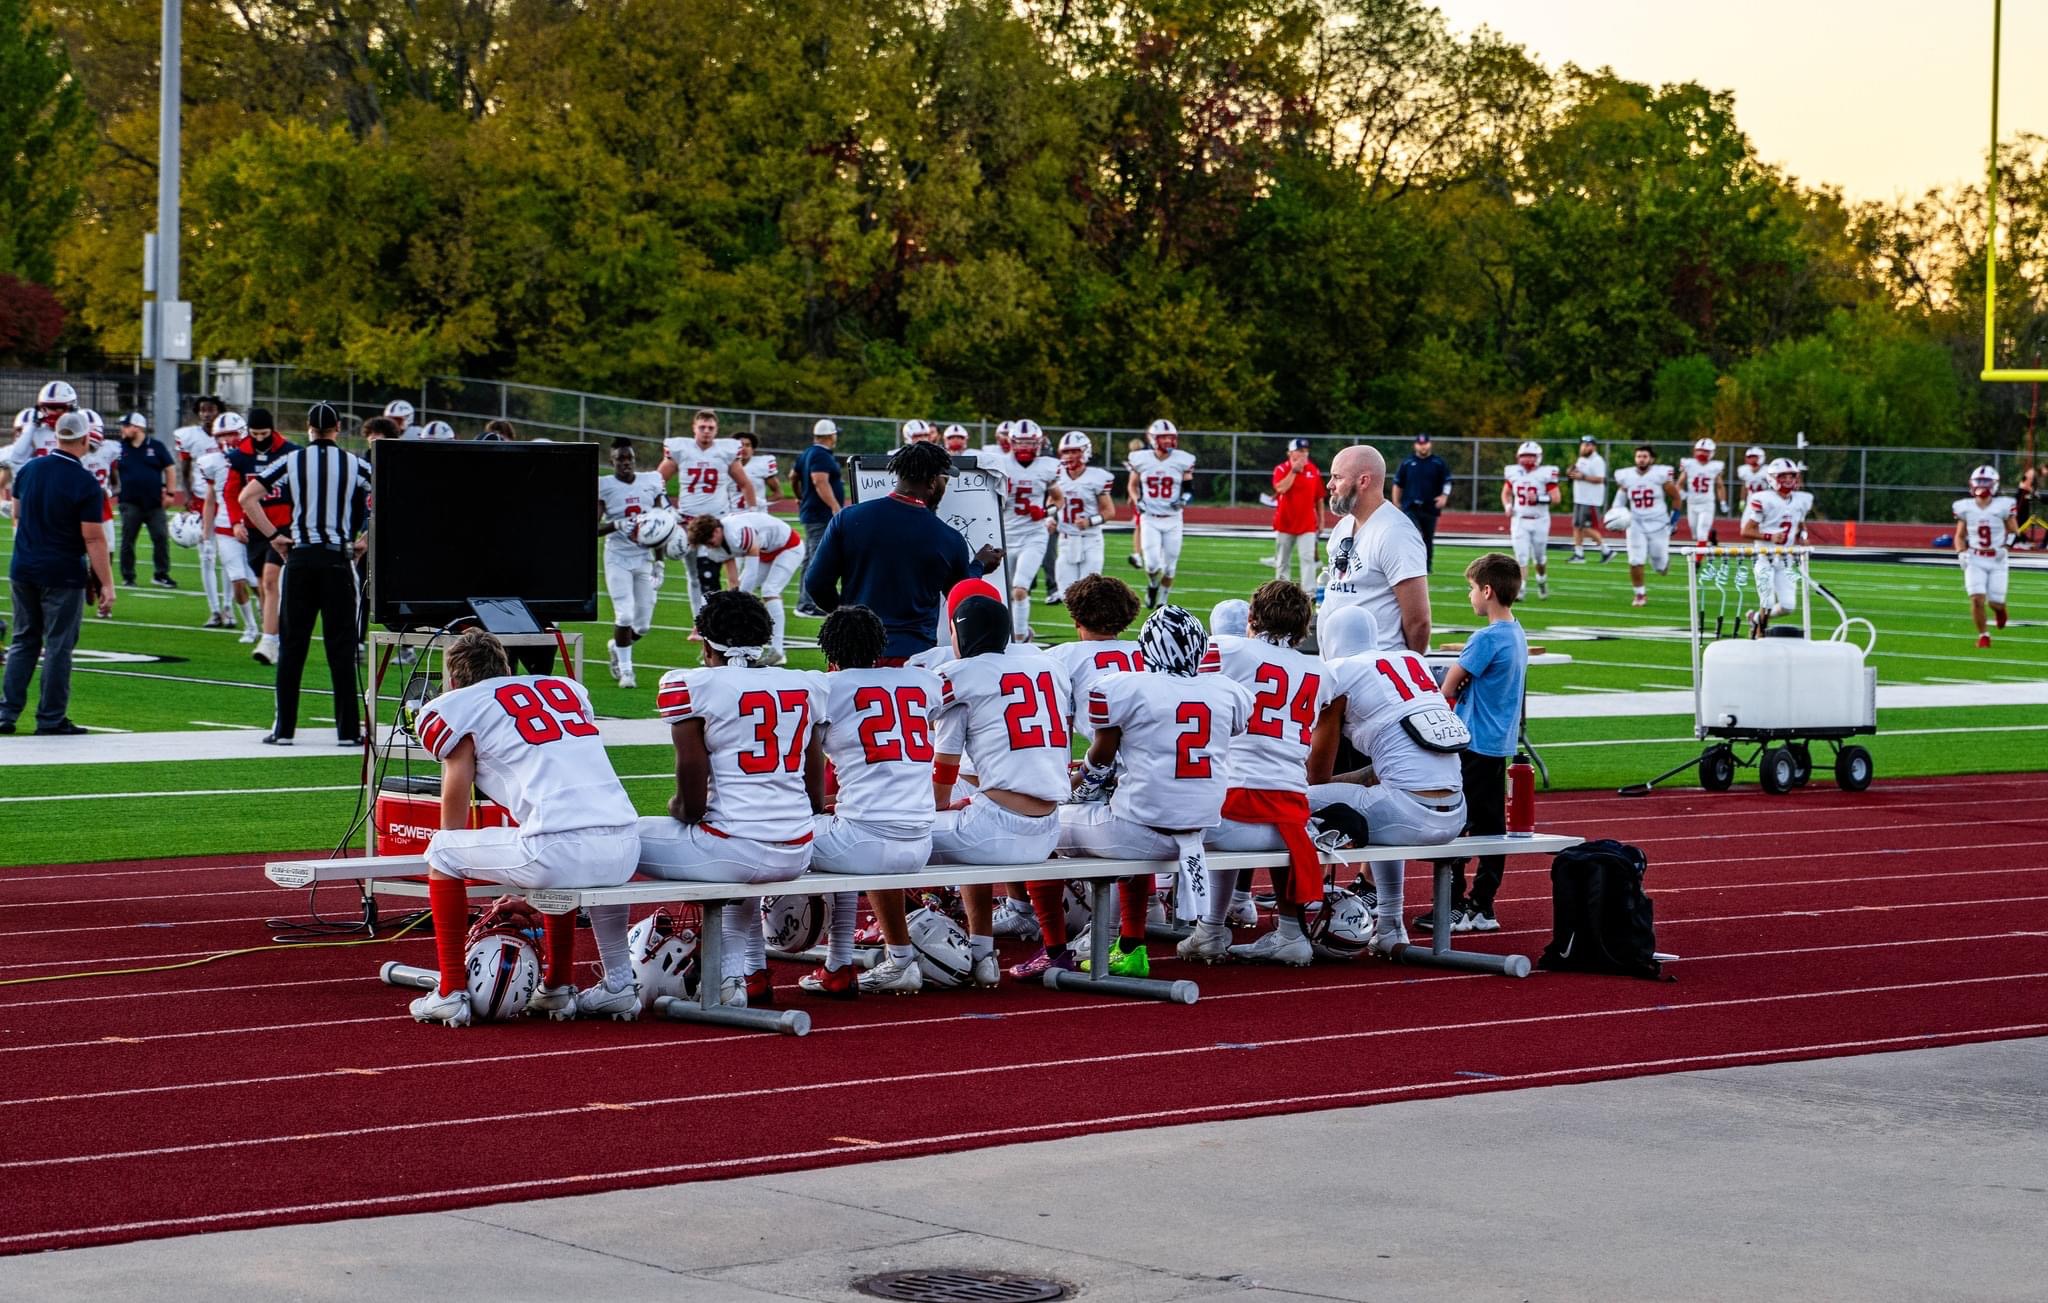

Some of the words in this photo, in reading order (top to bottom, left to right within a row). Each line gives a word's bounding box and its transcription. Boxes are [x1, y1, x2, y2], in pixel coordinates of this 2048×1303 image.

[687, 467, 719, 494] 79
[1146, 475, 1174, 499] 58
[1978, 525, 1992, 547] 9
[494, 678, 599, 746] 89
[1000, 671, 1067, 751] 21
[1247, 661, 1320, 746] 24
[1376, 655, 1439, 702] 14
[738, 689, 810, 775] 37
[854, 686, 934, 765] 26
[1175, 701, 1212, 779] 2
